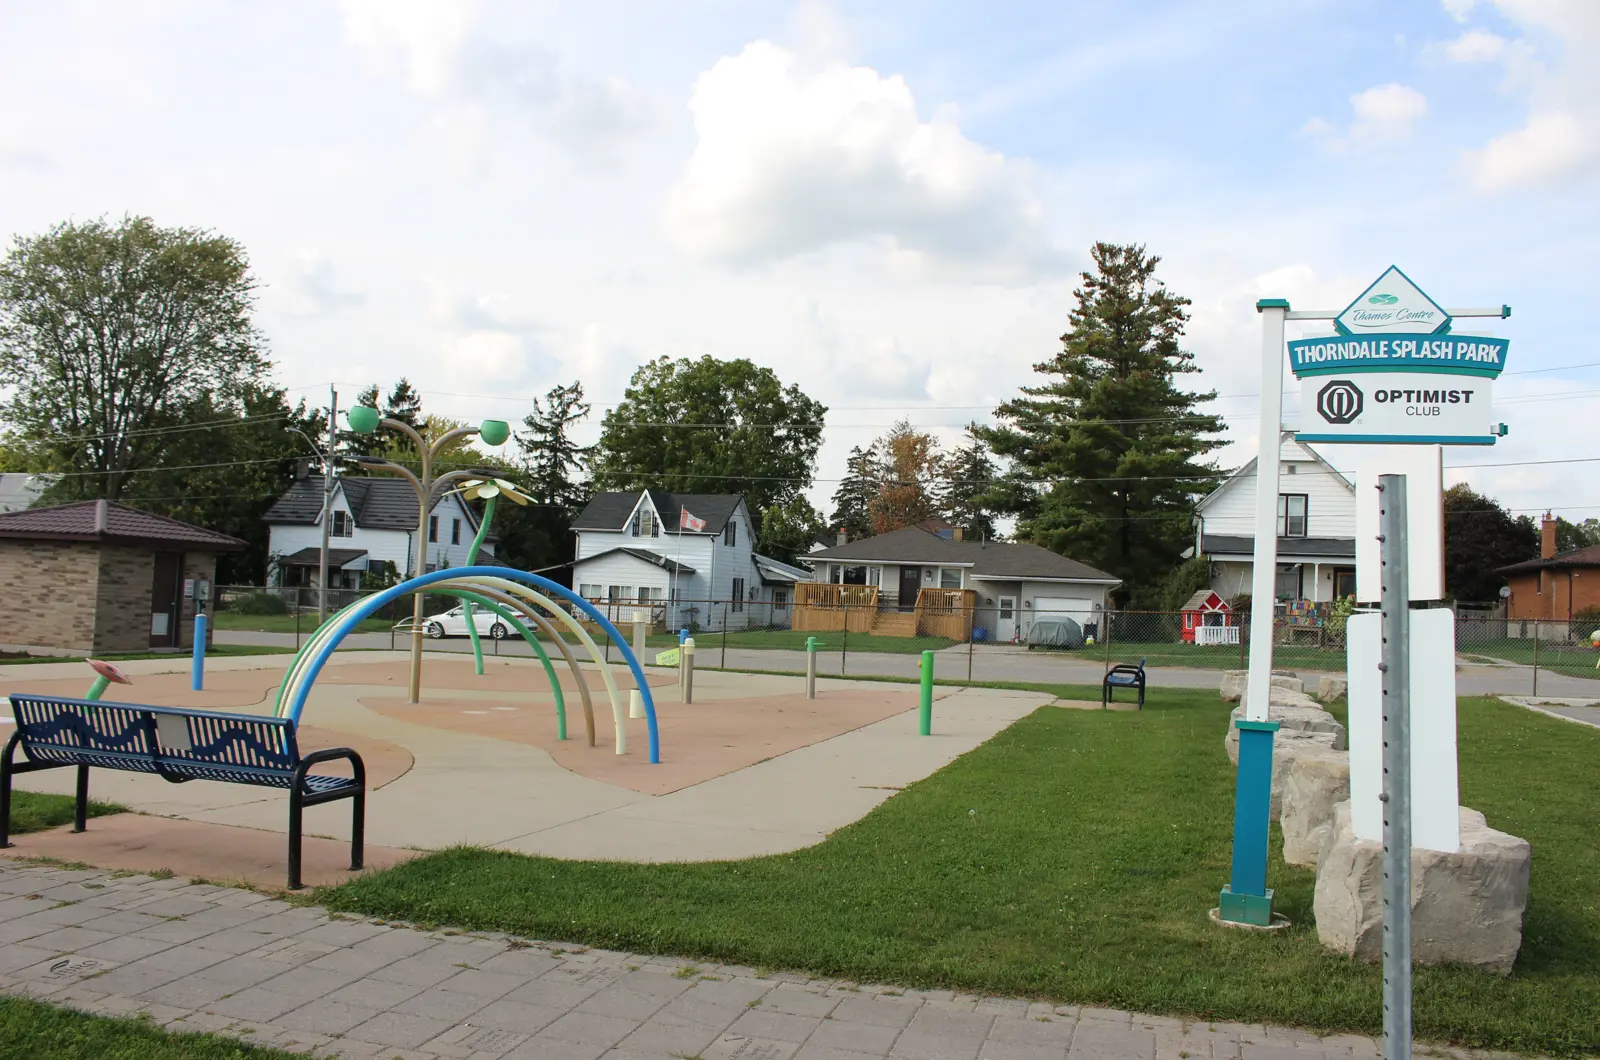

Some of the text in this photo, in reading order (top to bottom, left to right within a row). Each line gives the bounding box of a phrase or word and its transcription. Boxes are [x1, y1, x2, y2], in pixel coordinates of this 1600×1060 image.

[1353, 308, 1434, 321] Thames Centre
[1294, 340, 1501, 364] THORNDALE SPLASH PARK
[1374, 389, 1474, 403] OPTIMIST
[1406, 406, 1440, 416] CLUB
